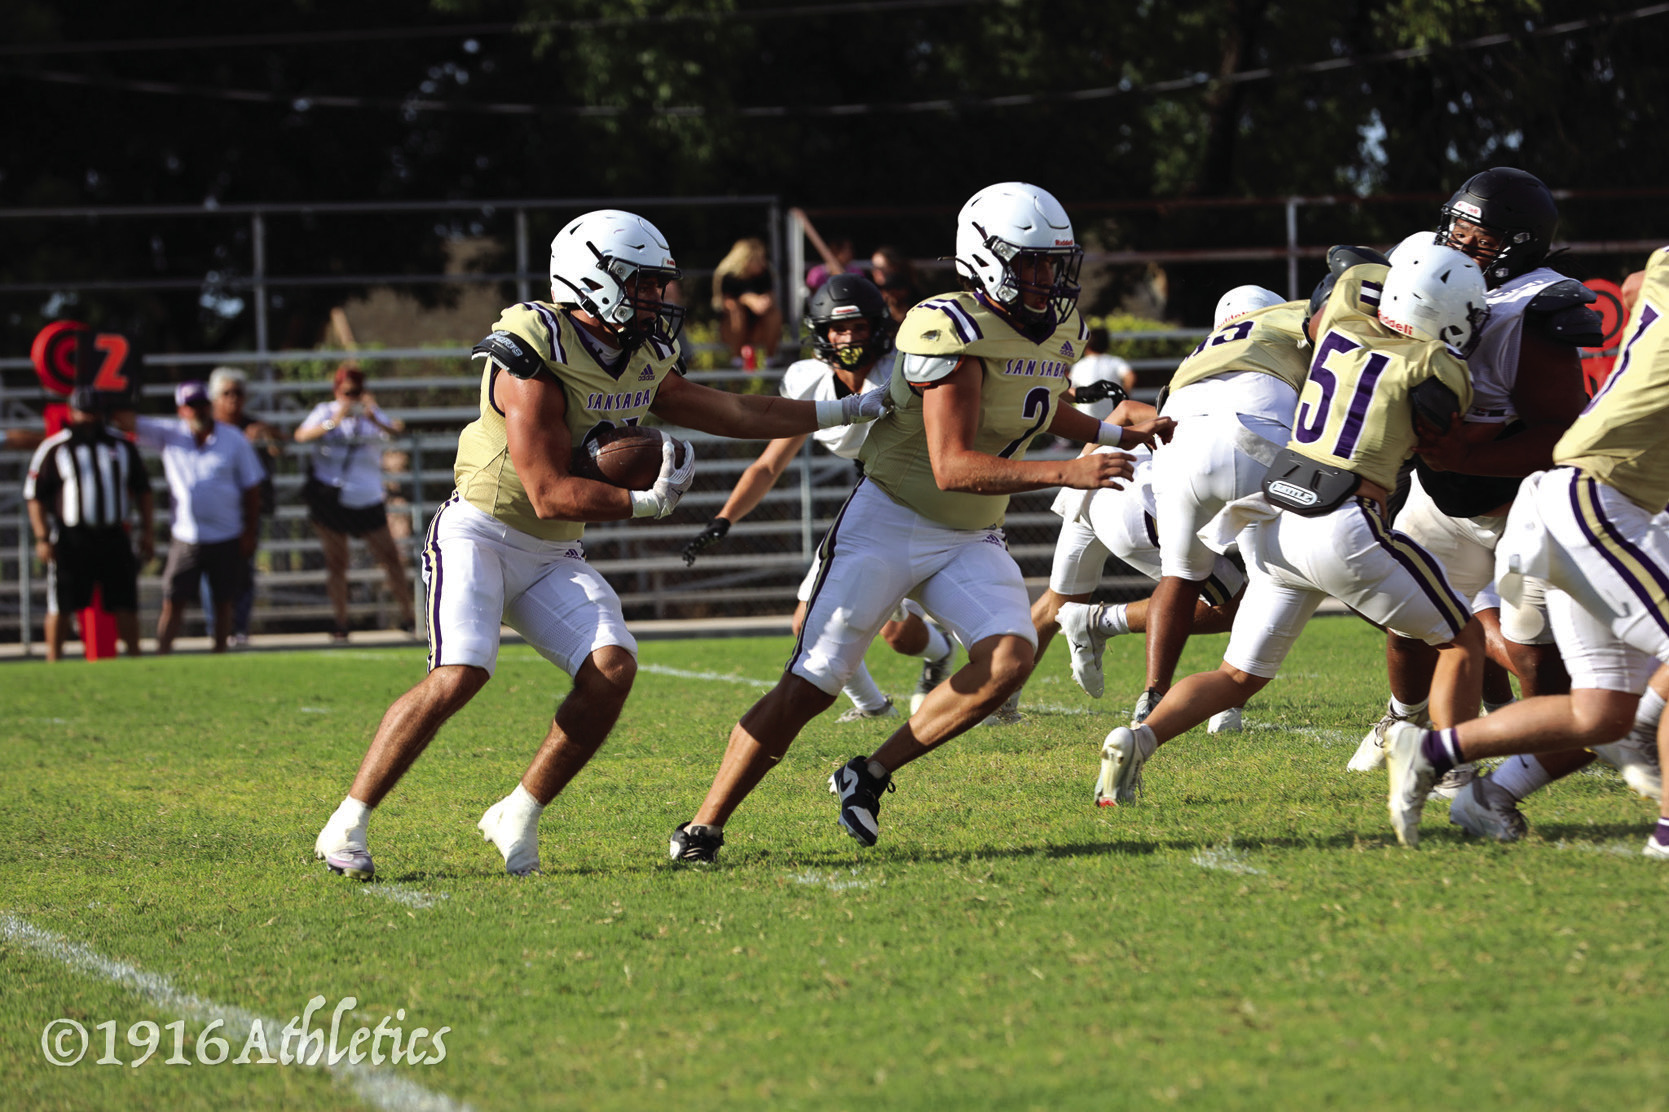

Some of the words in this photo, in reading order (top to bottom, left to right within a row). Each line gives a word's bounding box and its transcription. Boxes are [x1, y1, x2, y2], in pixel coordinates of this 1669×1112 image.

[94, 333, 129, 391] 2
[1003, 358, 1037, 377] SAN
[1294, 329, 1391, 461] 51
[997, 386, 1051, 460] 2
